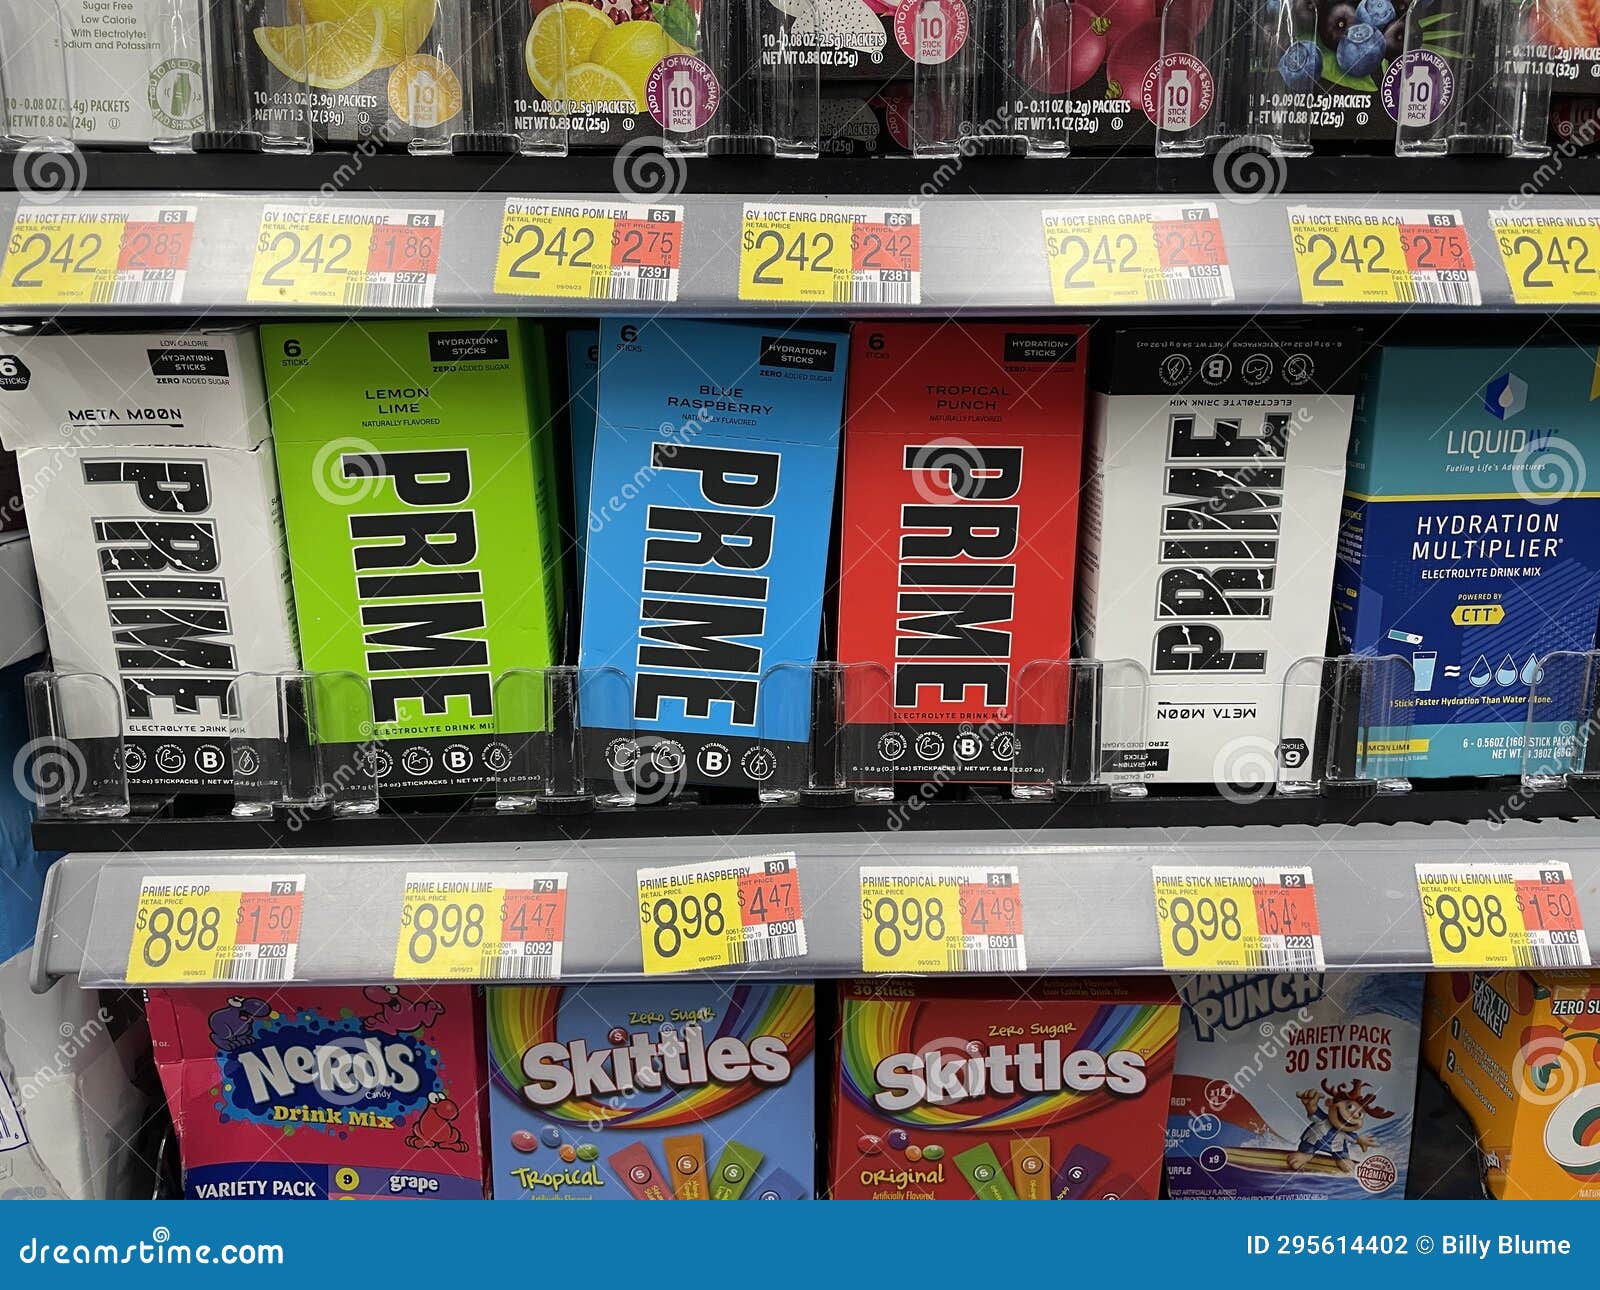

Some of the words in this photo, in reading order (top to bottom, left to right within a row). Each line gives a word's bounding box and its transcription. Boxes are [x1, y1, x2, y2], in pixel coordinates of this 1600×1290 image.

[81, 15, 100, 24] Low
[103, 15, 137, 24] Calorie
[72, 28, 92, 38] With
[922, 18, 942, 39] 10
[671, 87, 692, 108] 10
[1168, 87, 1187, 107] 10
[1408, 82, 1430, 103] 10
[91, 100, 130, 113] PACKETS
[339, 95, 377, 108] PACKETS
[597, 101, 636, 114] PACKETS
[1093, 100, 1131, 113] PACKETS
[1333, 95, 1371, 108] PACKETS
[1408, 104, 1427, 112] STICK
[72, 116, 97, 131] (24g)
[320, 110, 345, 126] (39g)
[1320, 111, 1344, 127] (25g)
[585, 117, 610, 134] (25g)
[1075, 118, 1099, 133] (32g)
[264, 211, 279, 222] GV
[282, 212, 307, 224] 10CT
[308, 213, 330, 224] E&E
[332, 214, 389, 226] LEMONADE
[508, 204, 523, 215] GV
[524, 205, 549, 216] 10CT
[551, 206, 580, 217] ENRG
[581, 208, 605, 219] POM
[607, 209, 628, 220] LEM
[653, 211, 671, 222] 65
[745, 211, 761, 221] GV
[763, 212, 788, 222] 10CT
[789, 212, 817, 222] ENRG
[820, 214, 867, 224] DRGNFRT
[17, 213, 32, 224] GV
[34, 213, 60, 224] 10CT
[61, 213, 77, 224] FIT
[79, 213, 100, 224] KIW
[101, 213, 130, 225] STRW
[412, 215, 430, 226] 64
[889, 214, 907, 225] 66
[1045, 217, 1059, 227] GV
[1062, 215, 1086, 226] 10CT
[1088, 215, 1116, 226] ENRG
[1118, 213, 1153, 225] GRAPE
[1291, 214, 1306, 225] GV
[1308, 215, 1332, 226] 10CT
[1334, 215, 1363, 226] ENRG
[1364, 216, 1379, 226] BB
[1381, 216, 1405, 226] ACAI
[1433, 215, 1451, 226] 68
[1511, 217, 1535, 227] 10CT
[1537, 217, 1565, 227] ENRG
[1566, 217, 1586, 227] WLD
[395, 272, 426, 283] 9572
[640, 266, 668, 277] 7391
[880, 270, 910, 281] 7381
[1191, 265, 1220, 277] 1035
[1438, 270, 1467, 281] 7360
[283, 339, 302, 358] 6
[451, 346, 487, 356] STICKS
[1024, 349, 1057, 358] STICKS
[365, 387, 430, 401] LEMON
[699, 385, 744, 398] BLUE
[925, 385, 1009, 397] TROPICAL
[378, 403, 421, 415] LIME
[668, 396, 774, 416] RASPBERRY
[937, 400, 997, 411] PUNCH
[68, 408, 121, 421] META
[1447, 428, 1527, 459] LIQUID
[1417, 513, 1559, 536] HYDRATION
[1151, 412, 1293, 676] PRIME
[894, 444, 1024, 708] PRIME
[1421, 567, 1488, 579] ELECTROLYTE
[1490, 567, 1520, 578] DRINK
[1522, 566, 1541, 577] MIX
[80, 456, 243, 720] PRIME
[339, 447, 494, 724] PRIME
[634, 441, 782, 727] PRIME
[1457, 593, 1492, 601] POWERED
[1493, 592, 1503, 600] BY
[1415, 697, 1439, 706] Faster
[1441, 696, 1480, 707] Hydration
[1481, 696, 1501, 705] Than
[1502, 696, 1527, 704] Water
[445, 723, 477, 732] DRINK
[402, 778, 448, 787] STICKPACKS
[769, 862, 785, 874] 80
[640, 878, 668, 891] PRIME
[670, 875, 695, 888] BLUE
[696, 867, 751, 884] RASPBERRY
[863, 877, 890, 887] PRIME
[892, 876, 937, 887] TROPICAL
[939, 877, 970, 887] PUNCH
[991, 875, 1006, 886] 81
[1156, 876, 1183, 887] PRIME
[1185, 876, 1212, 887] STICK
[1214, 876, 1266, 888] METAMOON
[1285, 875, 1301, 887] 82
[1420, 873, 1449, 885] LIQUID
[1450, 873, 1459, 884] IV
[1461, 873, 1492, 885] LEMON
[1493, 873, 1514, 884] LIME
[1545, 872, 1560, 883] 83
[142, 886, 171, 897] PRIME
[173, 886, 189, 896] ICE
[191, 885, 210, 896] POP
[276, 882, 292, 894] 78
[406, 882, 435, 893] PRIME
[437, 882, 469, 893] LEMON
[471, 882, 493, 893] LIME
[538, 880, 554, 892] 79
[768, 922, 796, 935] 6090
[990, 936, 1016, 947] 6091
[1286, 936, 1313, 948] 2223
[1552, 931, 1577, 944] 0016
[260, 945, 287, 957] 2703
[526, 942, 552, 955] 6092
[1552, 1000, 1585, 1016] ZERO
[1288, 1024, 1347, 1047] VARIETY
[1349, 1024, 1393, 1046] PACK
[522, 1024, 792, 1105] Skittles
[1285, 1050, 1310, 1074] 30
[1316, 1045, 1393, 1072] STICKS
[874, 1039, 1148, 1111] Skittles
[365, 1088, 393, 1101] Candy
[273, 1104, 343, 1126] Drink
[348, 1110, 396, 1131] Mix
[196, 1180, 269, 1200] VARIETY
[272, 1181, 317, 1197] PACK
[389, 1174, 439, 1193] grape
